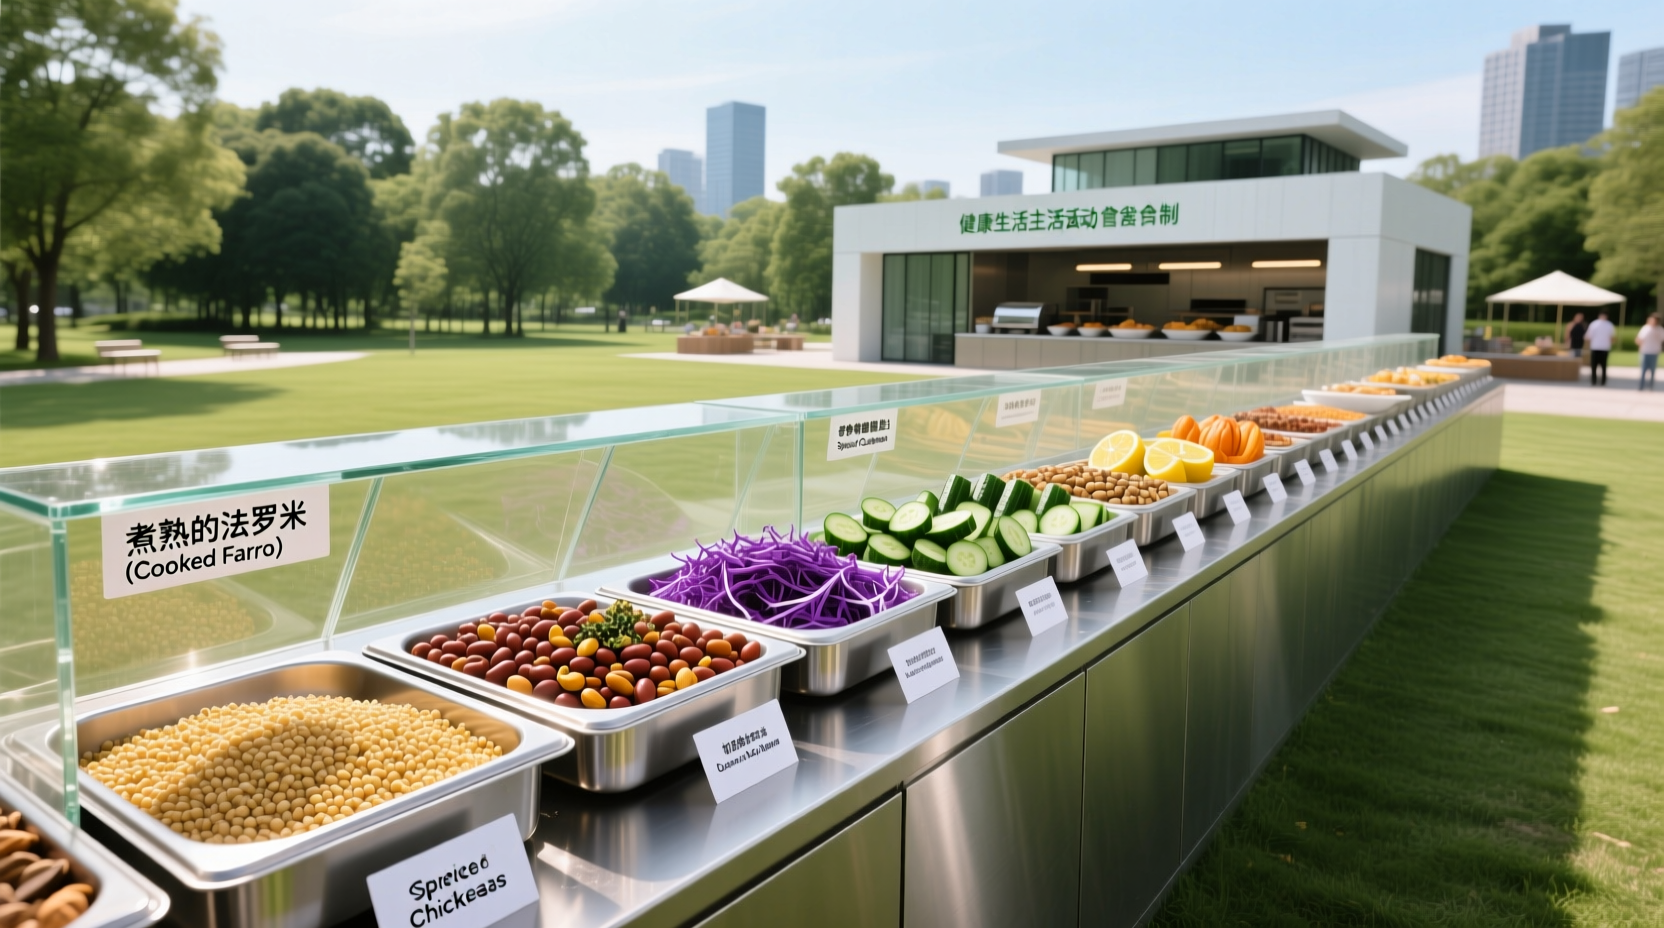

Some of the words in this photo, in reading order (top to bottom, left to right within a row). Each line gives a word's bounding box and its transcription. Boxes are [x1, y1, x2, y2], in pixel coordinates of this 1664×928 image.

[125, 499, 307, 557] 煮熟的法罗米
[125, 548, 216, 585] (Cooked
[222, 536, 283, 564] Farro)
